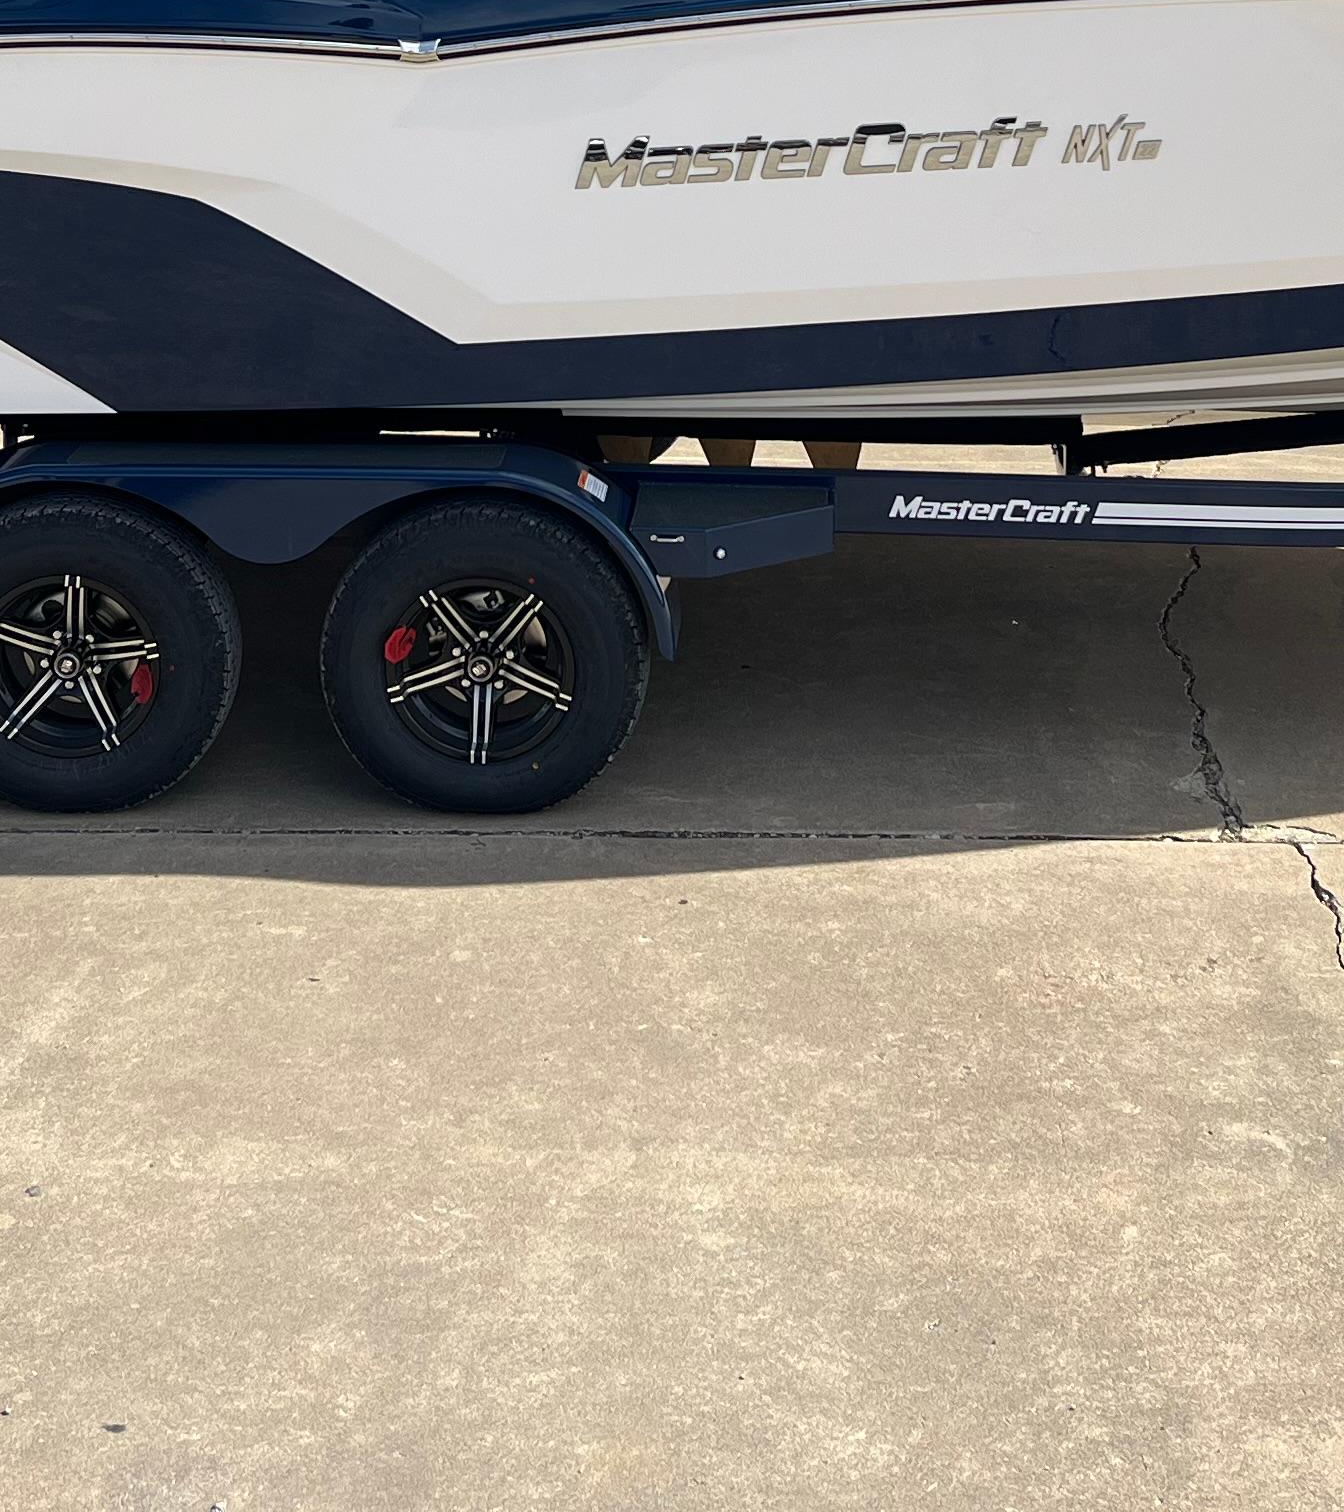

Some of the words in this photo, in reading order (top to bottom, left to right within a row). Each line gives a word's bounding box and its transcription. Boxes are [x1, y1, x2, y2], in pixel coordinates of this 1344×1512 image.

[574, 116, 1049, 190] MasterCraft
[1060, 113, 1147, 172] NXT
[888, 495, 1091, 525] MasterCraft
